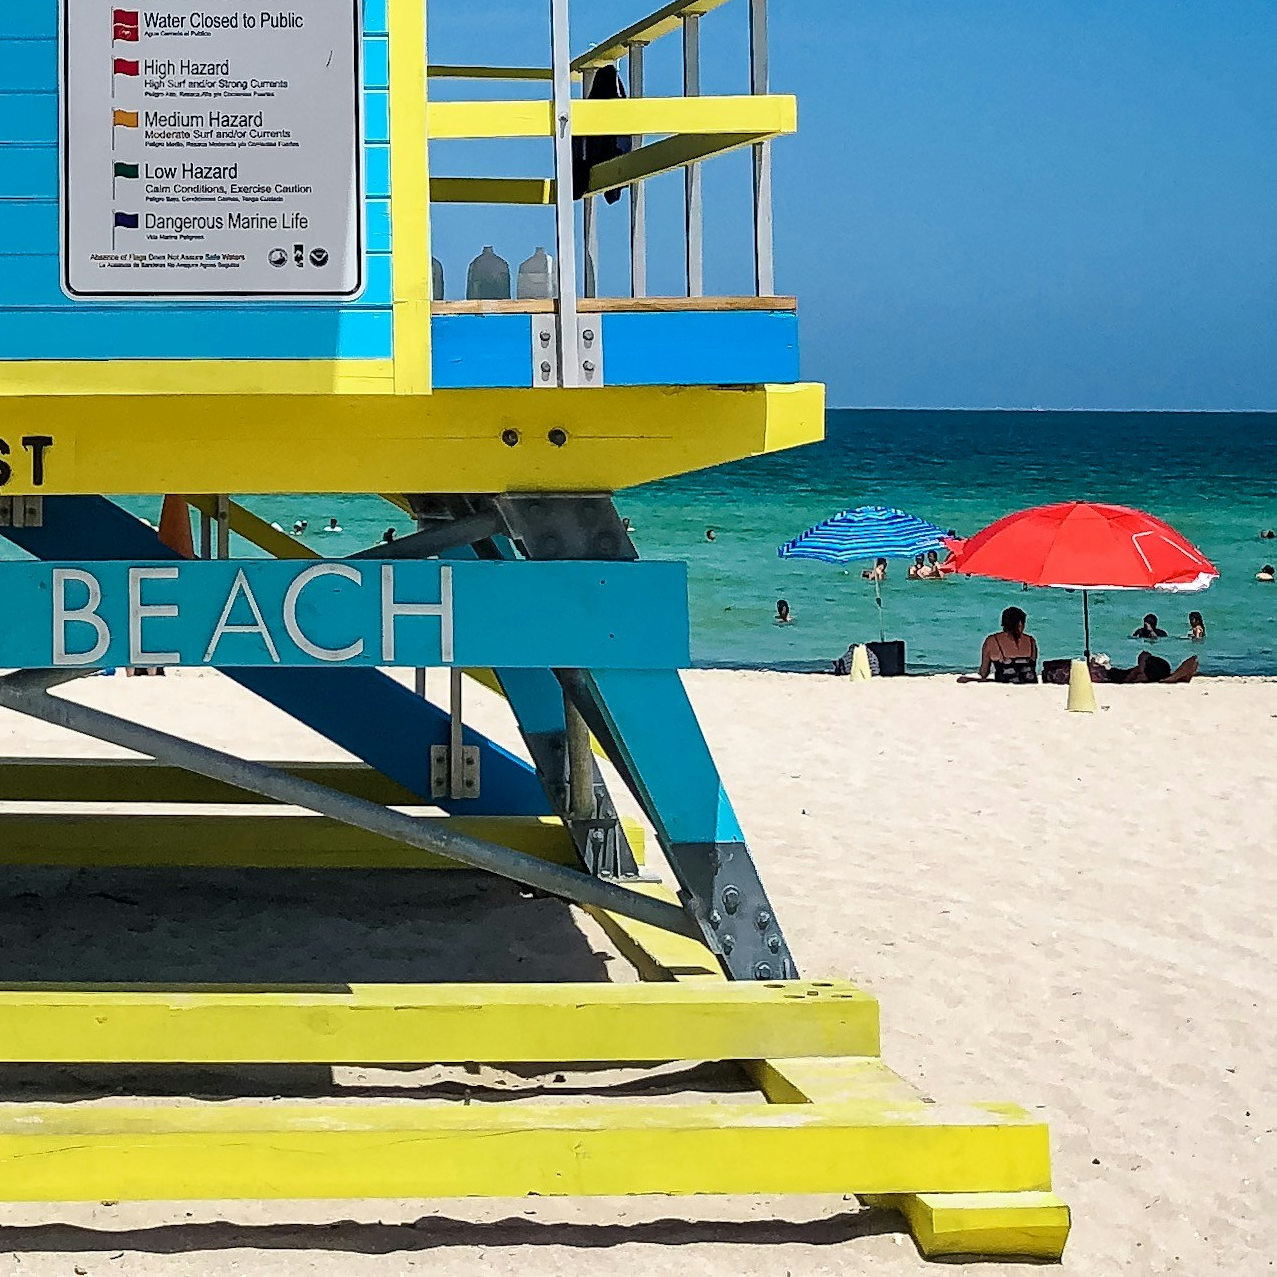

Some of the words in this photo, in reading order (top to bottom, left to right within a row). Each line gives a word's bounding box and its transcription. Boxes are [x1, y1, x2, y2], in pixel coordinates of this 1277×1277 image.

[144, 12, 186, 28] Water
[190, 12, 238, 28] Closed
[243, 12, 255, 28] to
[261, 12, 304, 28] Public
[144, 59, 175, 79] High
[180, 59, 229, 75] Hazard
[144, 80, 165, 90] High
[167, 80, 186, 88] Surf
[189, 80, 216, 88] and/or
[219, 80, 248, 90] Strong
[250, 80, 288, 88] Currents
[145, 111, 204, 127] Medium
[209, 111, 263, 127] Hazard
[145, 130, 190, 138] Moderate
[193, 130, 213, 138] Surf
[216, 130, 247, 138] and/or
[249, 130, 291, 138] Currents
[145, 163, 177, 179] Low
[182, 163, 237, 179] Hazard
[145, 185, 171, 193] Calm
[173, 185, 227, 195] Conditions,
[230, 185, 272, 193] Exercise
[275, 185, 312, 193] Caution
[145, 213, 223, 232] Dangerous
[228, 213, 277, 229] Marine
[282, 213, 308, 229] Life
[52, 563, 454, 665] BEACH
